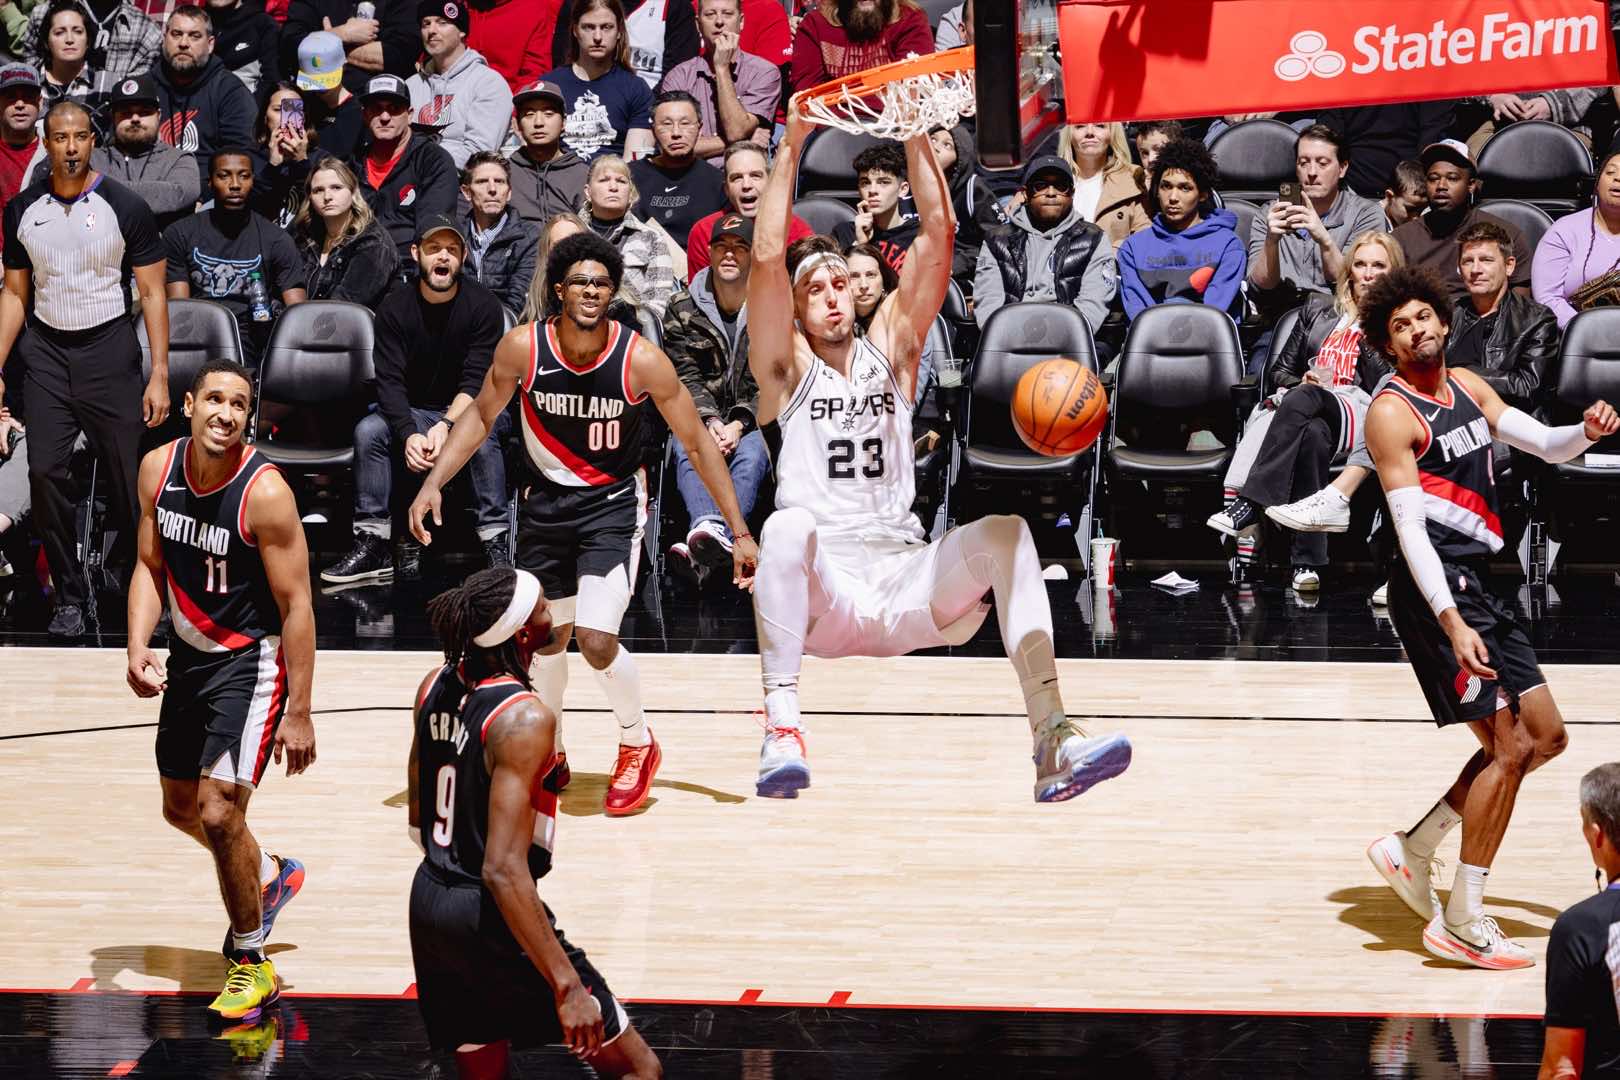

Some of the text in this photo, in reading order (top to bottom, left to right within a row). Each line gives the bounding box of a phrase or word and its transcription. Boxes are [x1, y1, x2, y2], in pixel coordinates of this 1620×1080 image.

[1352, 12, 1599, 74] State Farm
[533, 390, 625, 419] PORTLAND
[810, 391, 896, 424] SPURS
[588, 420, 620, 451] 00
[1436, 416, 1493, 463] PORTLAN
[827, 437, 886, 479] 23
[157, 506, 231, 556] PORTLAND
[205, 555, 228, 594] 11
[429, 712, 470, 756] GRAN
[433, 764, 457, 848] 9
